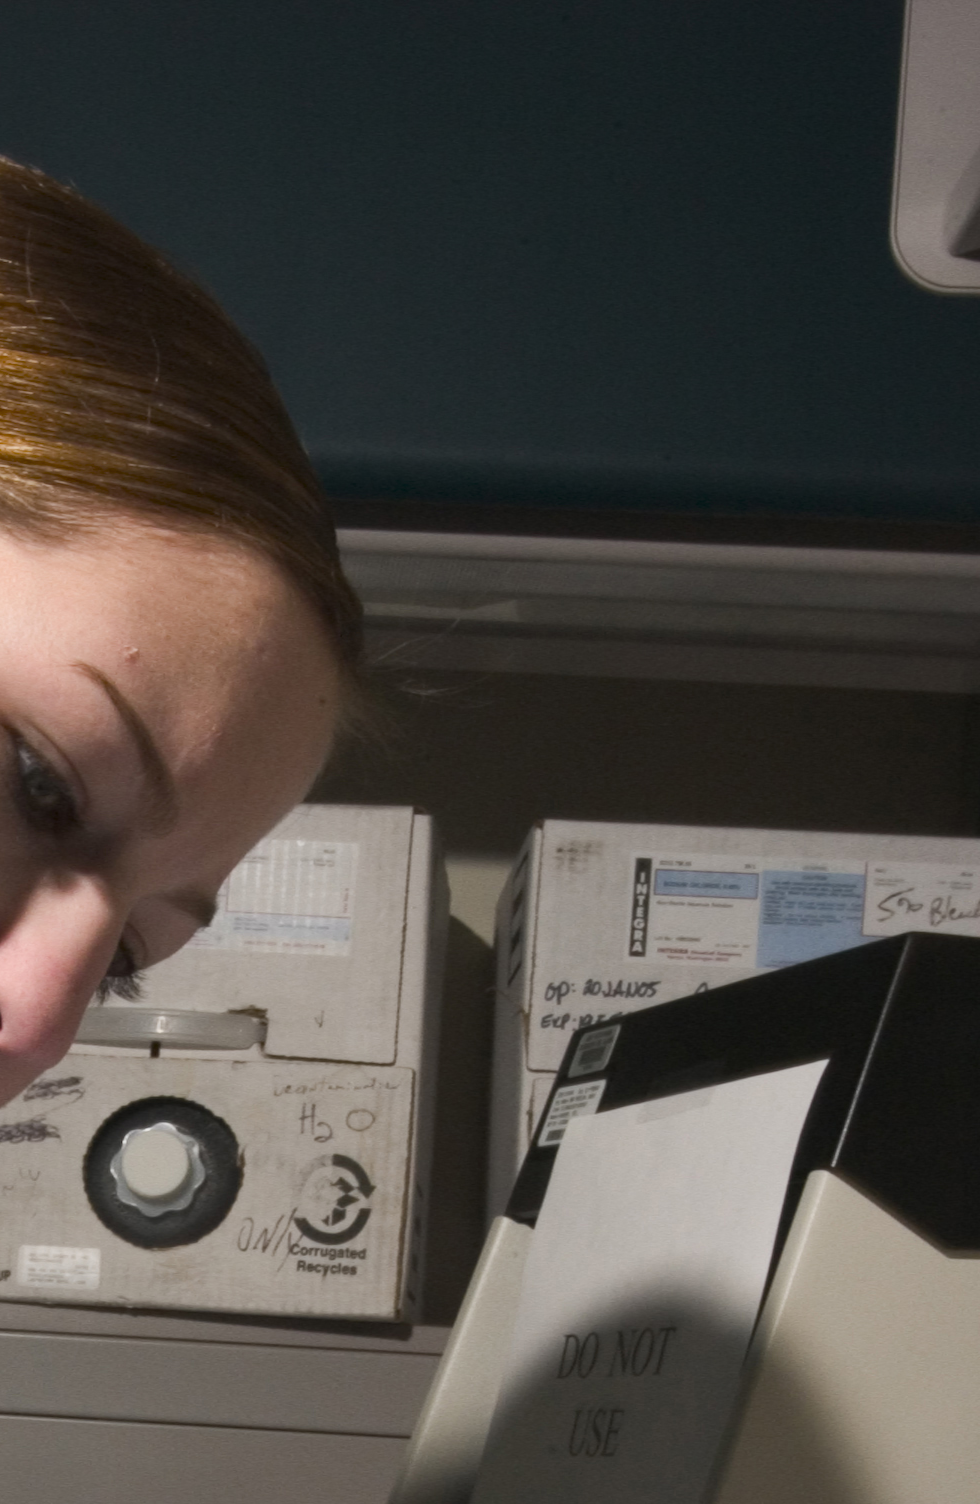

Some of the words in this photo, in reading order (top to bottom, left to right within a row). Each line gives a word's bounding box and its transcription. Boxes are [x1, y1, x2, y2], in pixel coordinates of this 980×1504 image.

[631, 871, 648, 953] INTEGRA
[290, 1243, 367, 1262] Corrugated
[296, 1259, 358, 1277] Recycles
[556, 1331, 599, 1379] DO
[608, 1326, 677, 1378] NOT
[569, 1408, 624, 1457] USE
